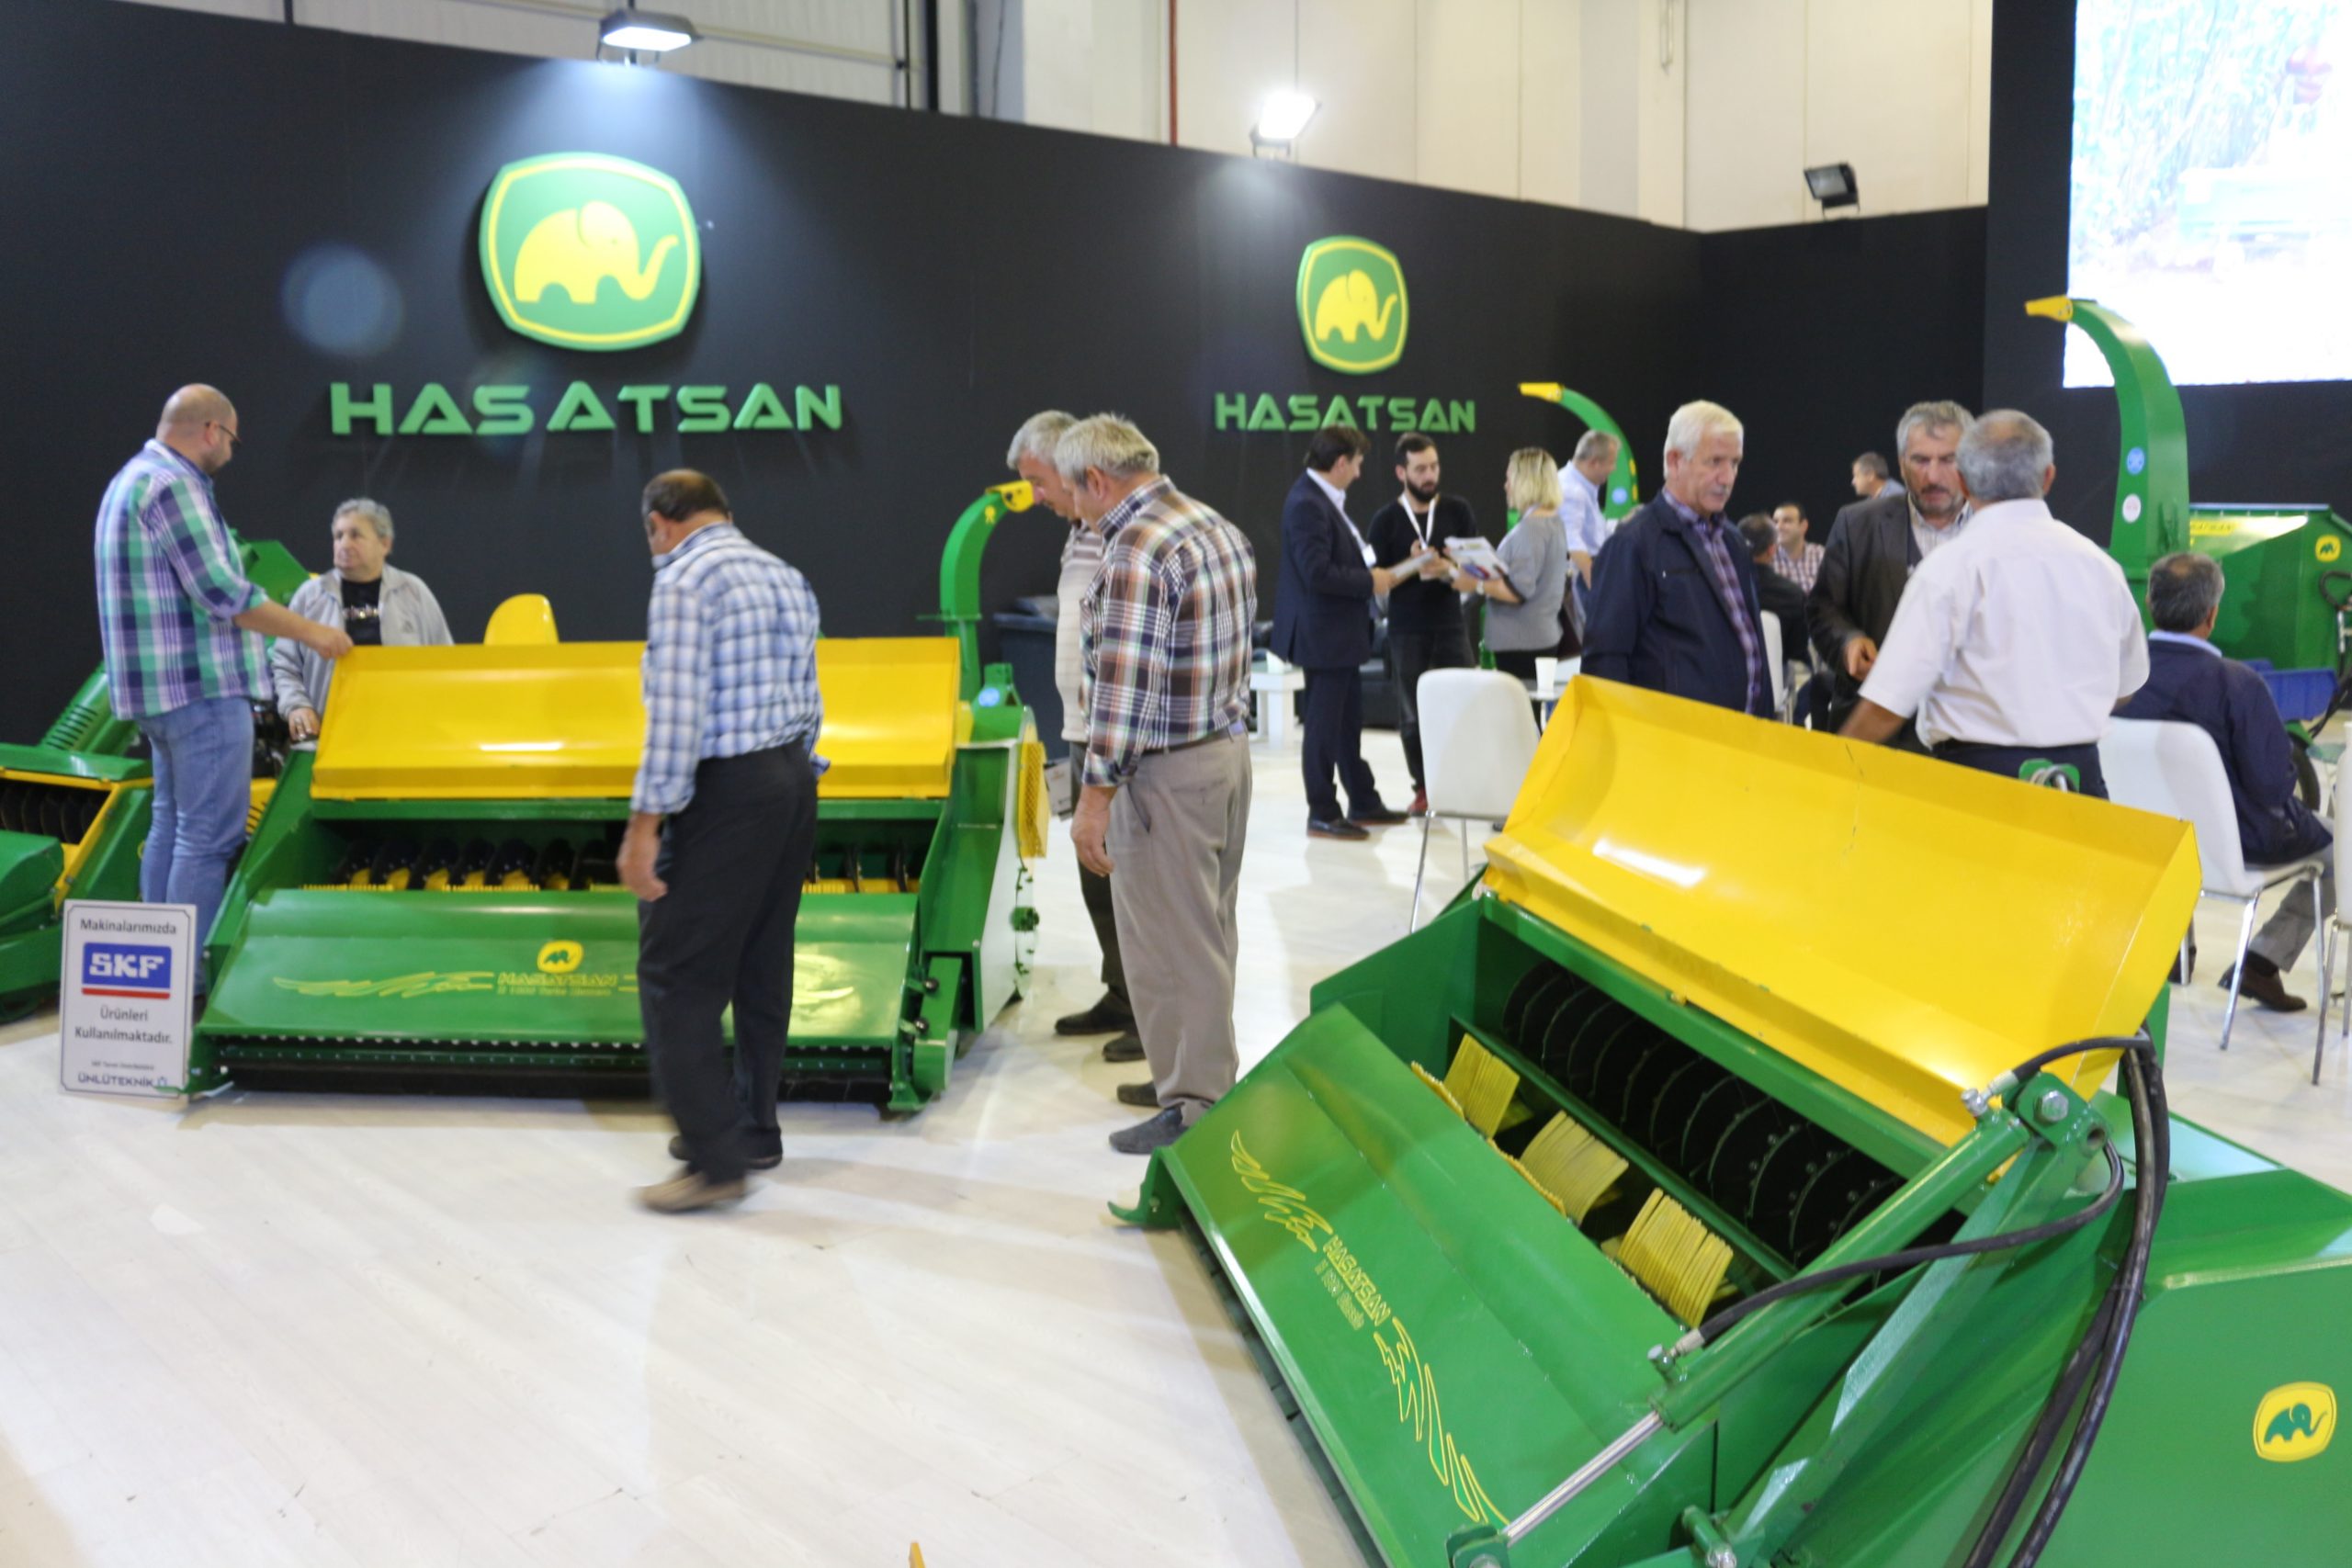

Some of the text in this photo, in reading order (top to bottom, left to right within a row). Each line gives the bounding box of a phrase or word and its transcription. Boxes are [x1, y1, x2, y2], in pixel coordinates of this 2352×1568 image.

[330, 380, 842, 435] HASATSAN
[1215, 392, 1476, 433] HASATSAN
[80, 919, 176, 935] Makinalarımızda
[89, 953, 164, 979] SKF
[100, 1005, 149, 1021] Ürünleri
[75, 1027, 172, 1043] Kullanılmaktadır.
[1323, 1235, 1391, 1327] HASATSAN
